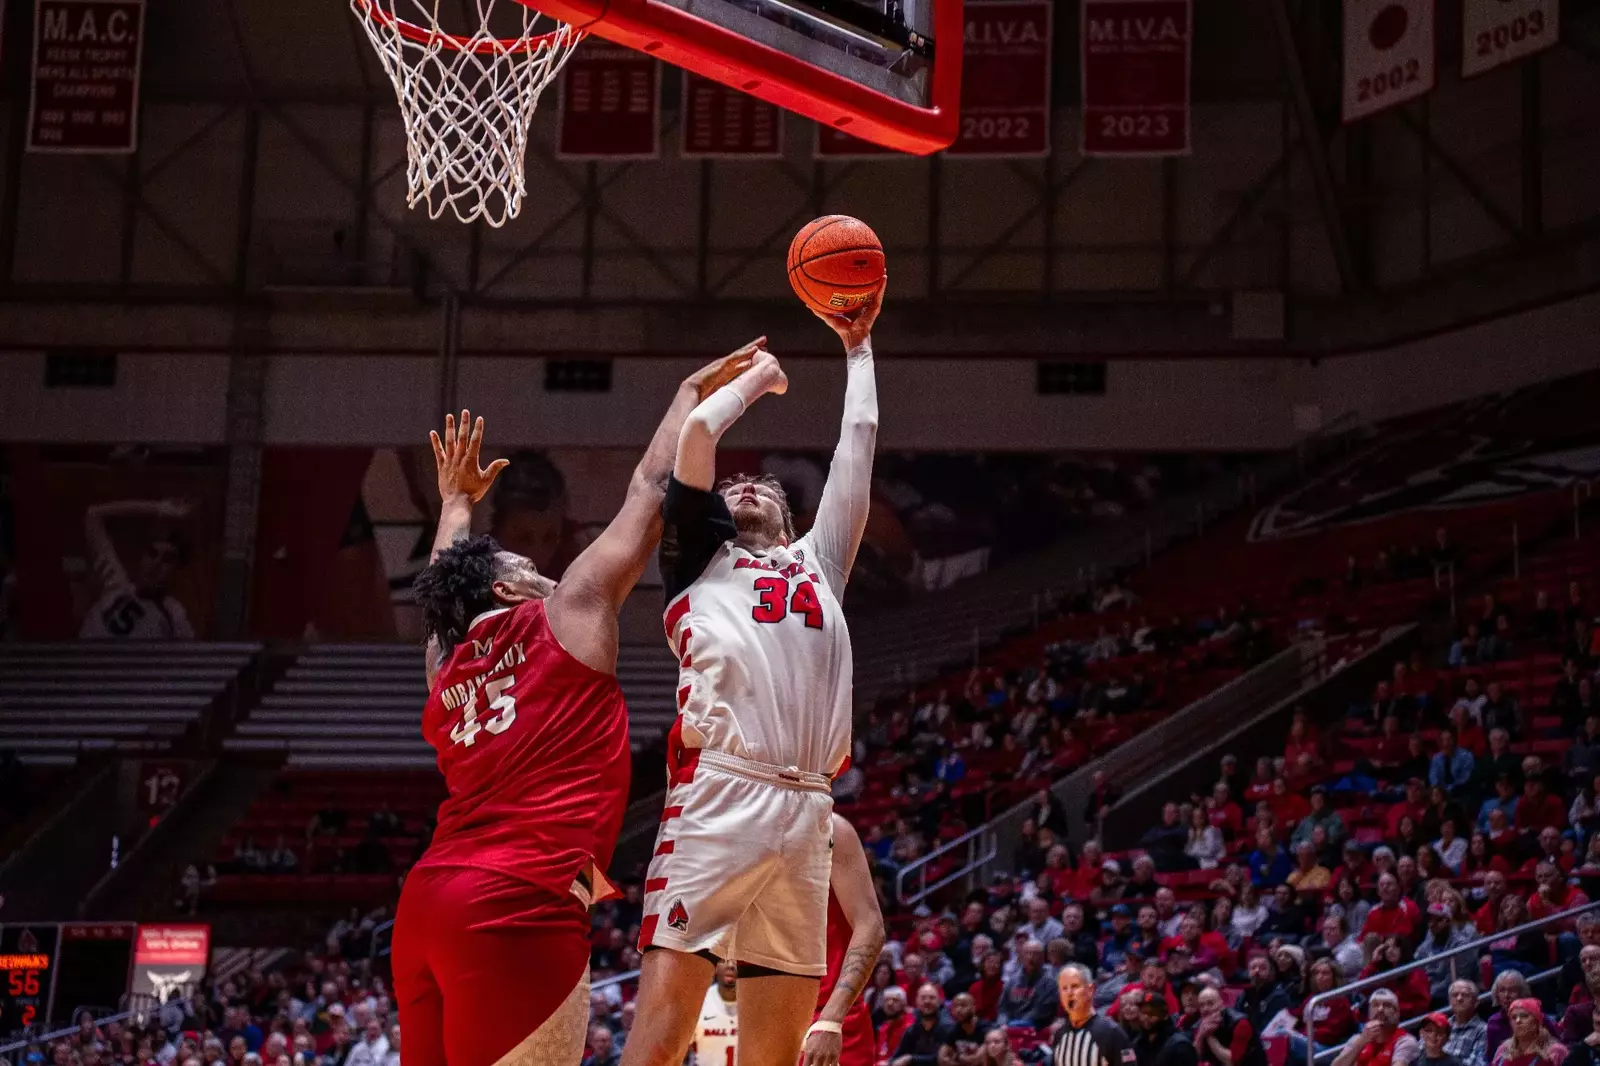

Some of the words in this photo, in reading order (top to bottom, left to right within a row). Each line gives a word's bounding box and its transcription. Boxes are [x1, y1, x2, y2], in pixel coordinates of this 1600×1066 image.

[43, 8, 136, 43] M.A.C.
[1476, 9, 1544, 56] 2003
[1357, 59, 1420, 102] 2002
[962, 117, 1031, 139] 2022
[1100, 115, 1170, 137] 2023
[733, 557, 778, 572] BAL
[752, 576, 824, 630] 34
[471, 636, 494, 659] M
[449, 673, 517, 748] 45
[8, 968, 40, 997] 56
[703, 1028, 727, 1037] BALL
